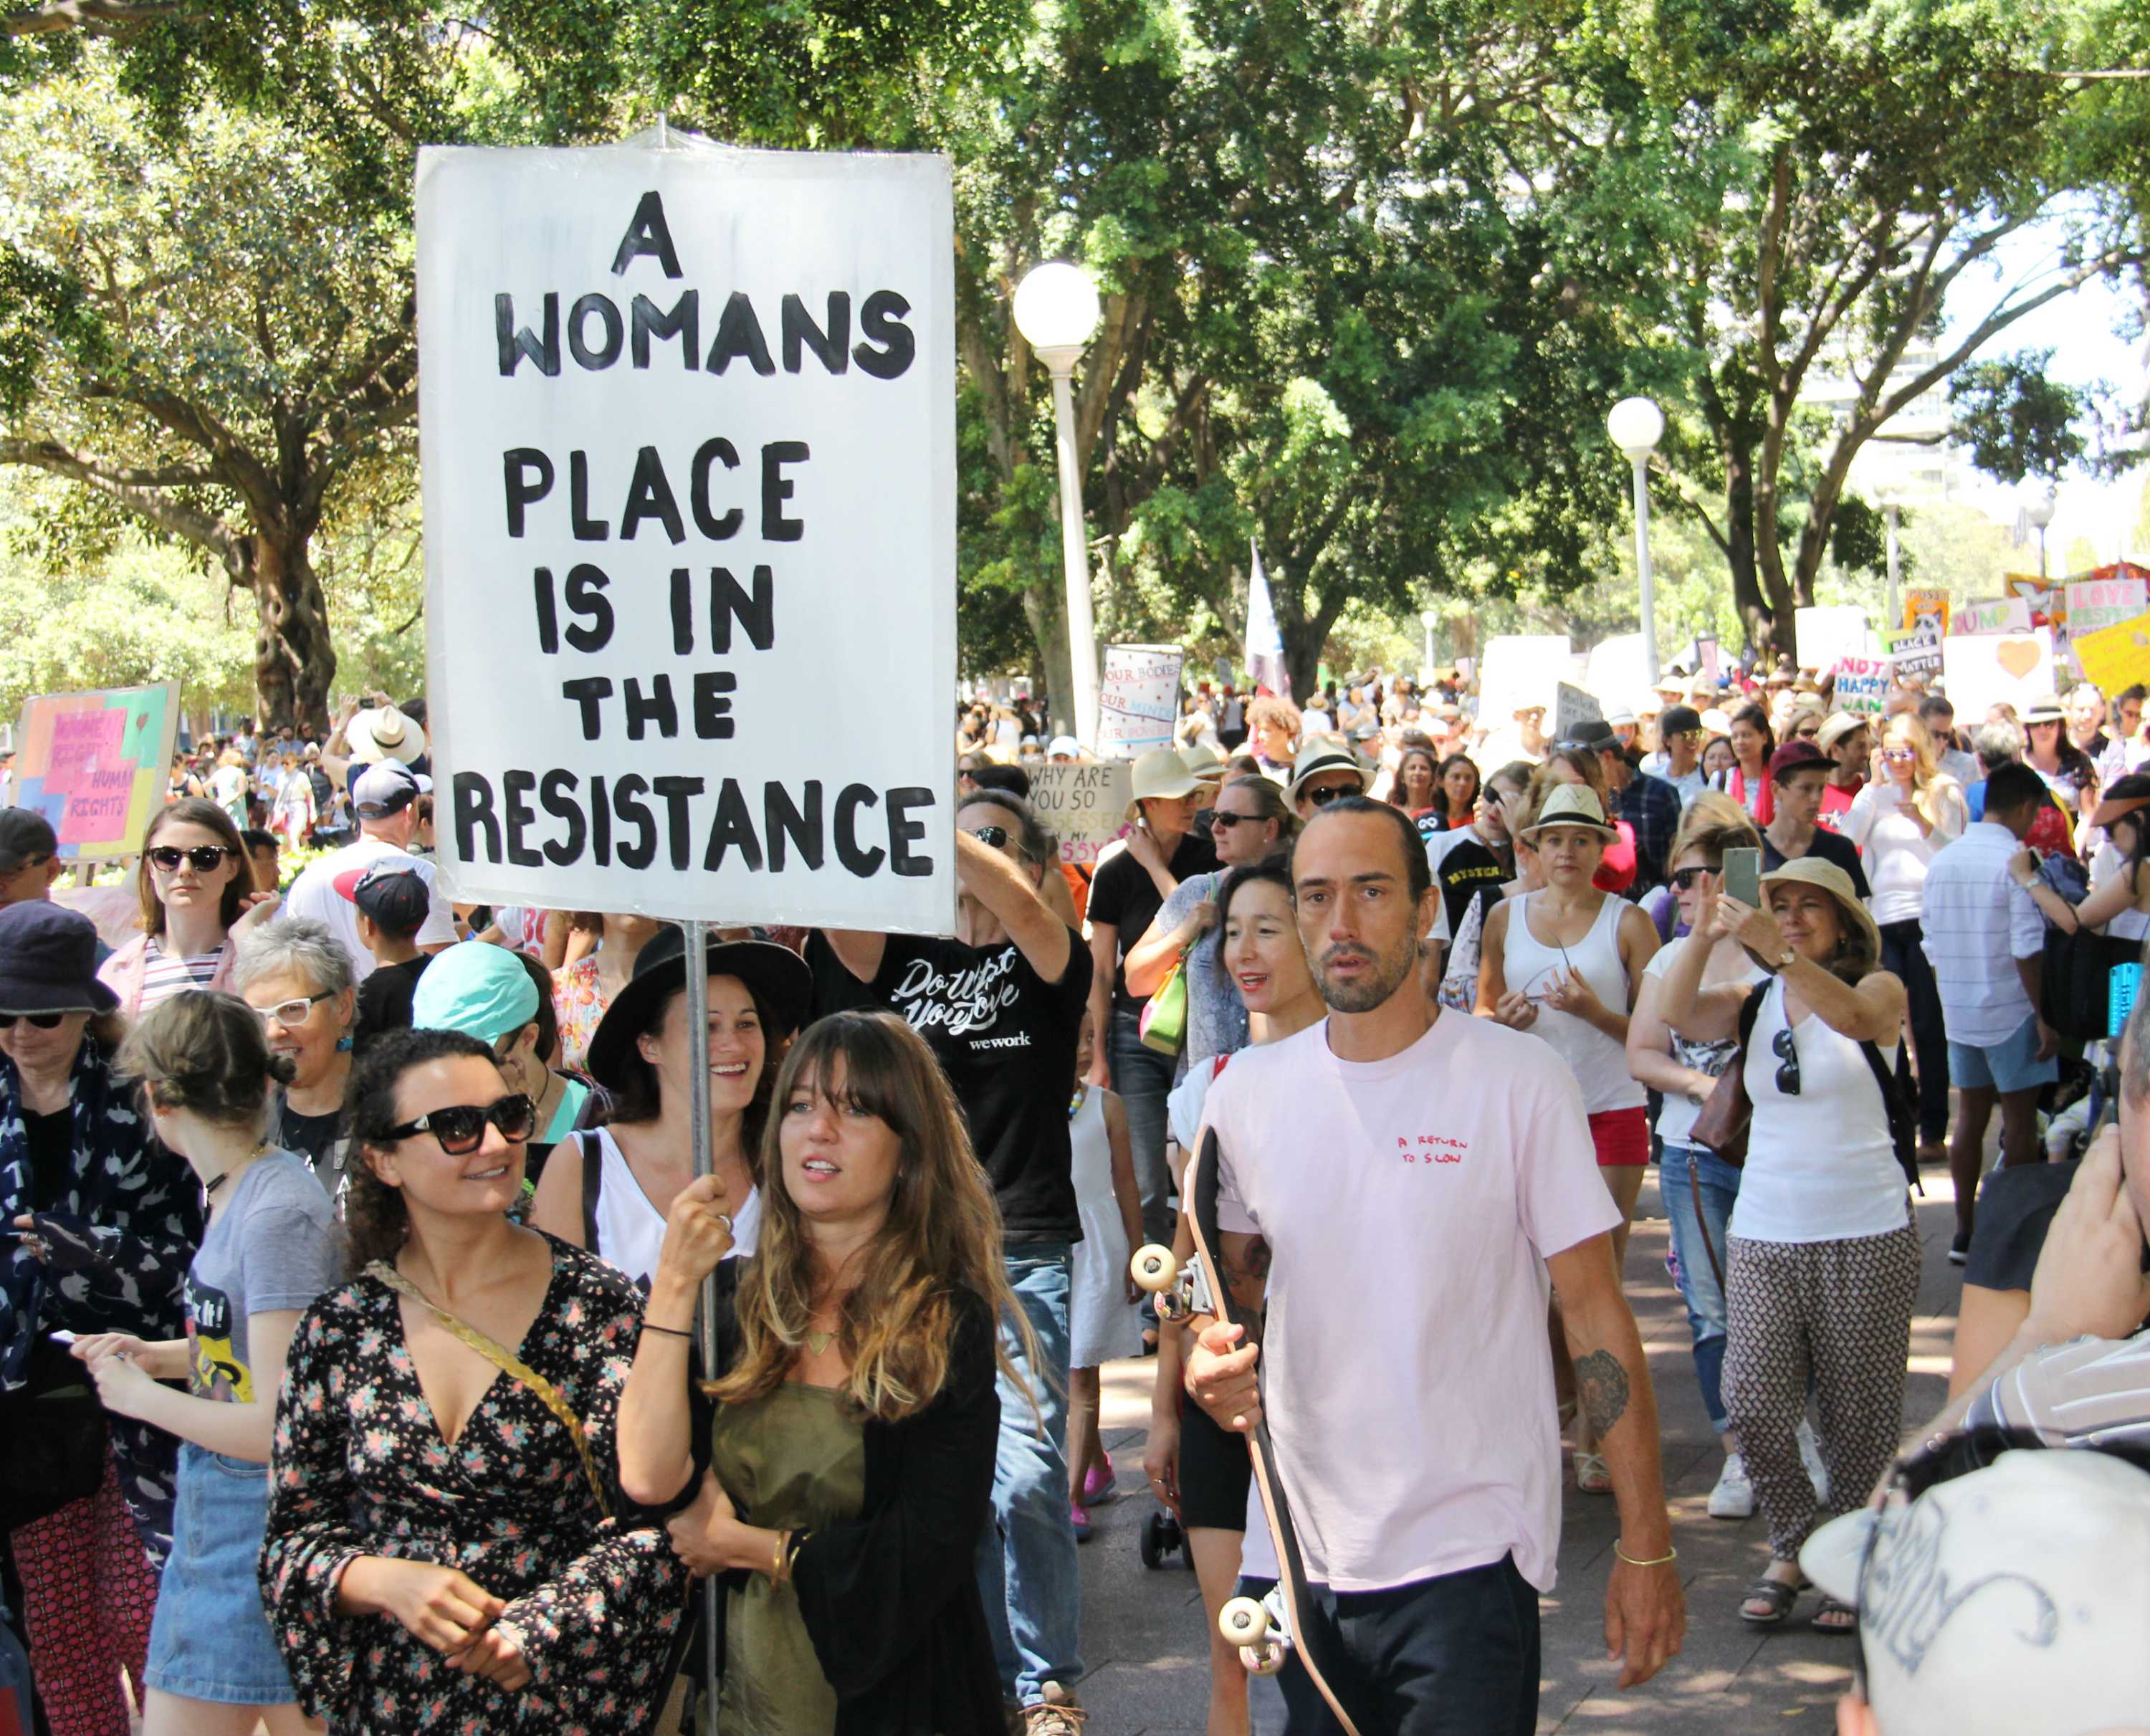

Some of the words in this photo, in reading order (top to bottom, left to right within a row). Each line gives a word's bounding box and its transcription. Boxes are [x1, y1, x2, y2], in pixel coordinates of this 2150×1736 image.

[611, 191, 684, 278] A
[494, 289, 915, 379] WOMANS
[504, 437, 810, 545] PLACE
[2074, 584, 2133, 608] LOVE
[534, 563, 614, 654] IS
[670, 564, 774, 655] IN
[1106, 669, 1134, 681] OUR
[1138, 664, 1182, 677] BODIES
[1840, 657, 1886, 675] NOT
[1837, 677, 1889, 695] HAPPY
[563, 672, 736, 740] THE
[1101, 692, 1126, 709] OUR
[1841, 698, 1882, 712] JAN
[92, 768, 133, 788] HUMAN
[1028, 768, 1066, 786] WHY
[1074, 767, 1112, 788] ARE
[71, 795, 125, 817] RIGHTS
[1028, 790, 1064, 810] YOU
[1070, 790, 1095, 810] SO
[453, 768, 936, 878] RESISTANCE
[1071, 831, 1088, 841] MY
[969, 1031, 1031, 1050] wework
[1398, 1137, 1407, 1148] A
[1418, 1135, 1468, 1148] RETURN
[1403, 1154, 1415, 1163] TO
